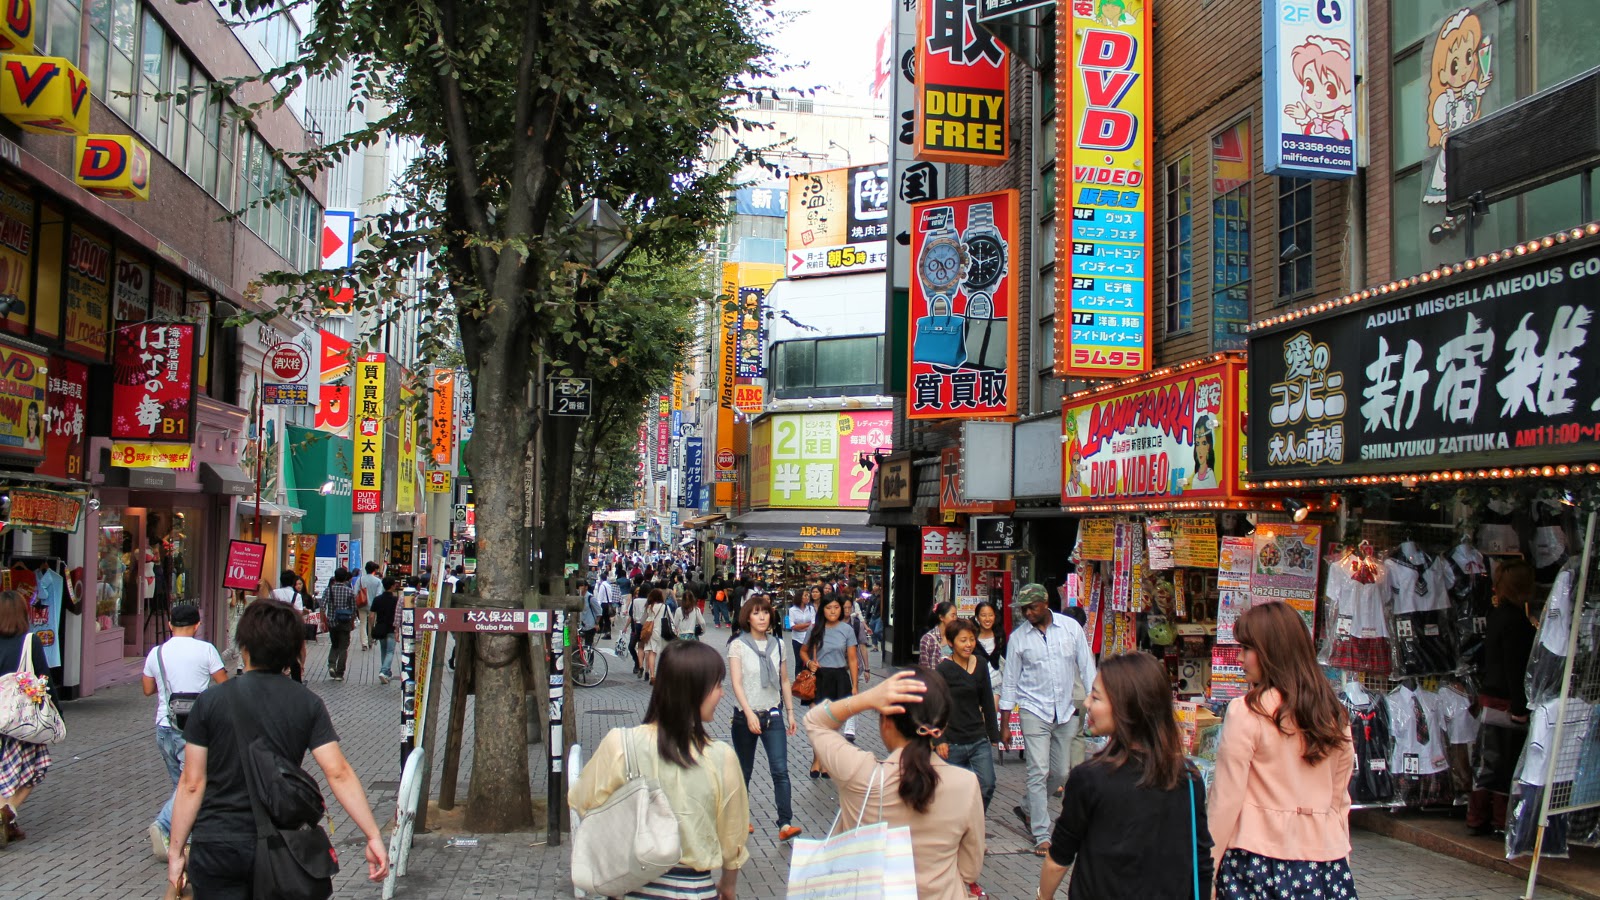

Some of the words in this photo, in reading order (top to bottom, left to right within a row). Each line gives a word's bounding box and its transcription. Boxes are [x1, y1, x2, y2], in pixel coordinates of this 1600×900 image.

[1283, 5, 1310, 22] 2F
[1077, 28, 1140, 151] DVD
[926, 90, 1003, 120] DUTY
[925, 119, 1002, 151] FREE
[1282, 140, 1351, 155] 03-3358-9055
[1282, 152, 1351, 166] milfiecafe.com
[1073, 166, 1143, 187] VIDEO
[1077, 188, 1140, 208] 販売店
[1073, 209, 1093, 220] 4F
[1105, 213, 1133, 224] グッズ
[1073, 244, 1093, 254] 3F
[1096, 247, 1141, 260] ハードコア
[1079, 261, 1134, 274] インディーズ
[1073, 278, 1093, 289] 2F
[1104, 282, 1132, 294] ビデ倫
[1078, 295, 1134, 308] インディーズ
[1366, 306, 1411, 329] ADULT
[1415, 267, 1563, 317] MISCELLANEOUS
[1073, 314, 1092, 324] 1F
[1073, 330, 1143, 343] アイドルイメージ
[166, 327, 181, 382] 海鮮居酒屋
[1074, 349, 1141, 366] ラムタラ
[1284, 331, 1330, 381] 愛の
[274, 357, 300, 370] 消火栓
[1360, 303, 1600, 433] 新宿雑
[135, 325, 168, 434] はなの舞
[278, 390, 307, 398] セキネ
[736, 388, 762, 400] ABC
[1198, 382, 1221, 409] 激安
[1269, 372, 1346, 425] コンビニ
[736, 402, 762, 410] MART
[163, 418, 184, 434] B1
[806, 420, 832, 429] ビジネス
[806, 429, 831, 437] シューズ
[805, 438, 832, 454] 足目
[1112, 438, 1131, 454] ラムタラ
[1131, 435, 1163, 452] 新宿駅東口店
[1269, 425, 1343, 464] 大人の市場
[1360, 440, 1435, 460] SHINJYUKU
[1438, 431, 1510, 455] ZATTUKA
[112, 446, 189, 464] 朝8時まで営業中
[360, 438, 376, 486] 大黒屋
[68, 455, 81, 474] B1
[774, 462, 834, 500] 半額
[800, 526, 840, 536] ABC-MART
[923, 531, 968, 555] 金券
[467, 610, 525, 624] 大久保公園
